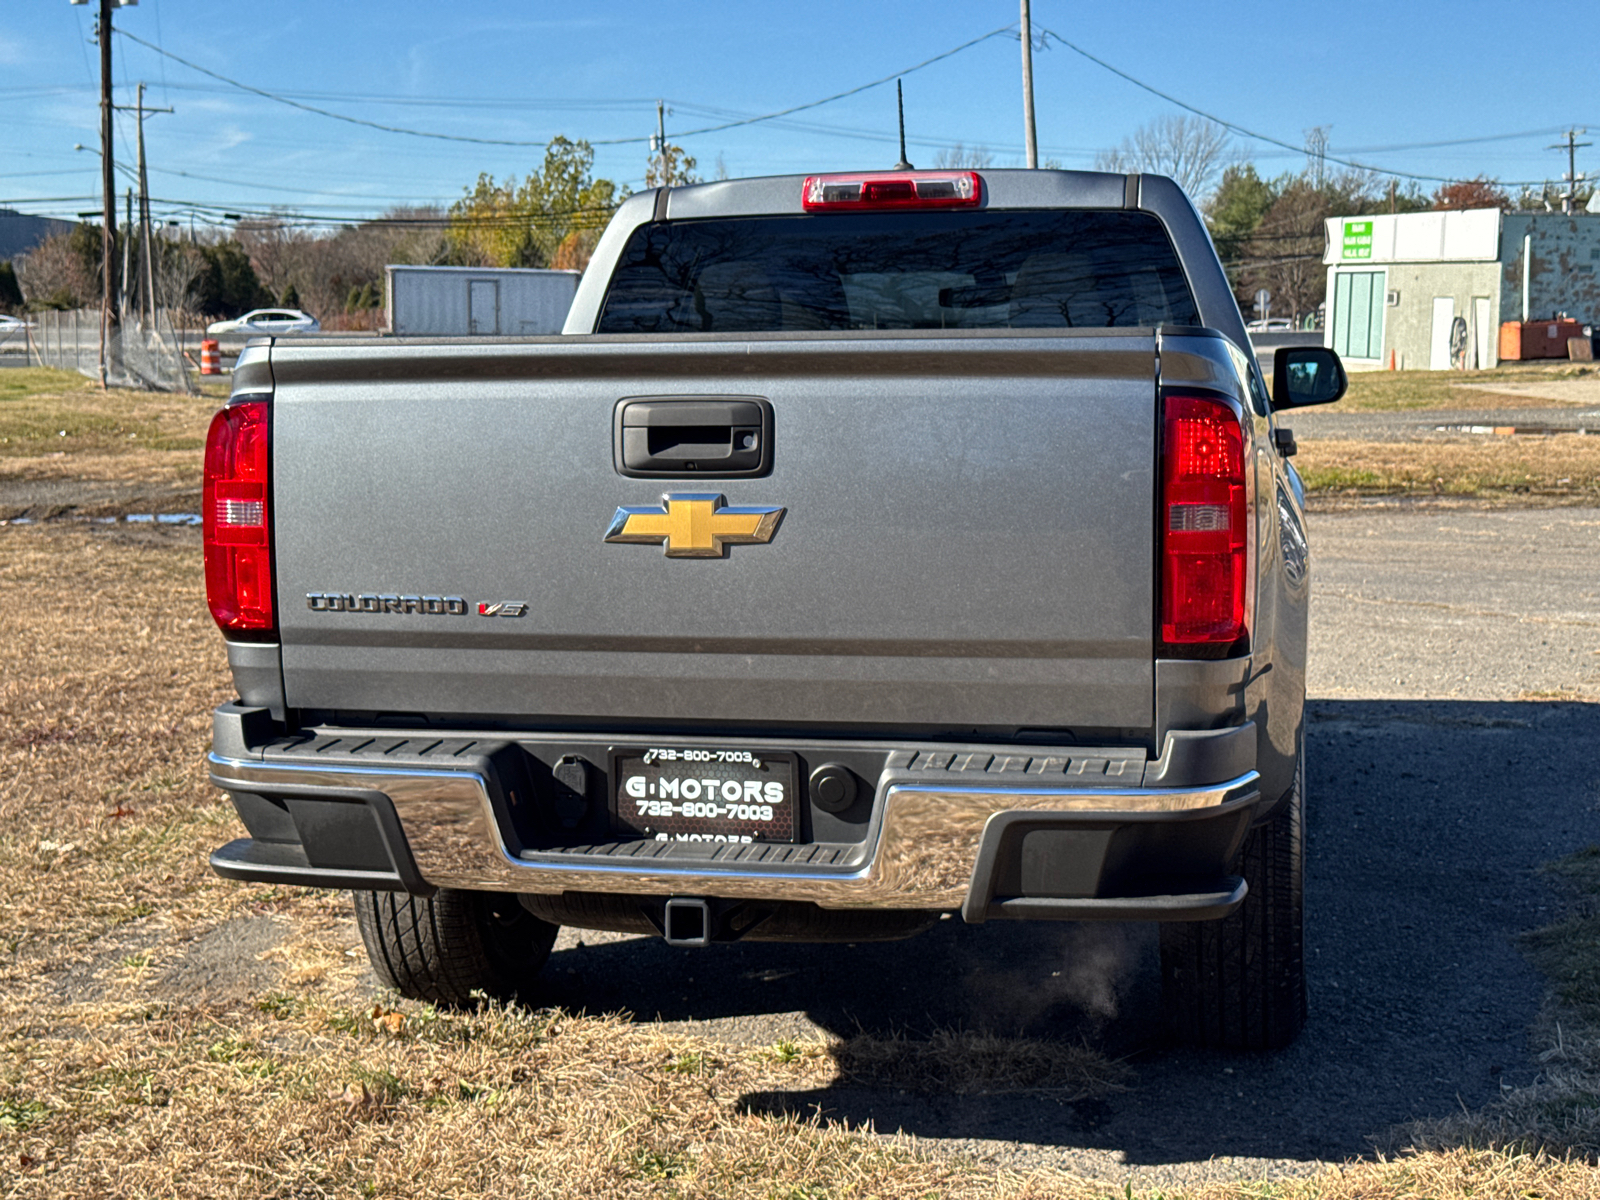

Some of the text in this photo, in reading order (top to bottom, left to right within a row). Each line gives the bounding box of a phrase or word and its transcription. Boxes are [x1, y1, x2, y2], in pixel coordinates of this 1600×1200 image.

[306, 592, 465, 615] COLORADO
[649, 748, 753, 762] 732-800-7003
[635, 800, 773, 821] 732-800-7003
